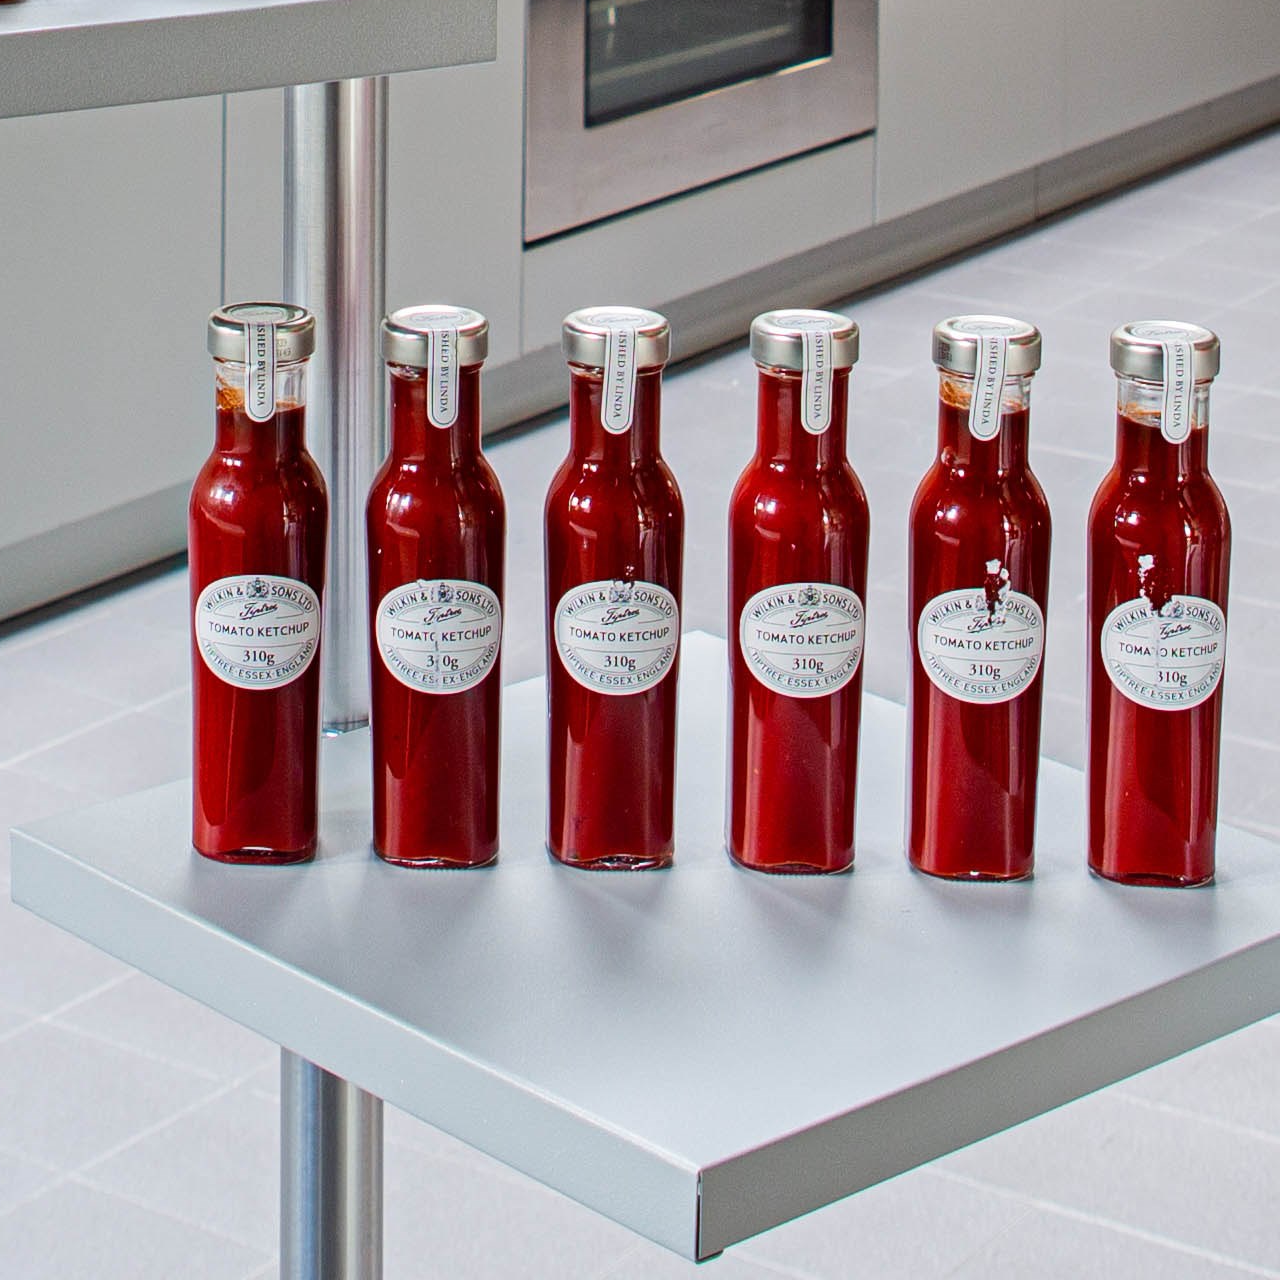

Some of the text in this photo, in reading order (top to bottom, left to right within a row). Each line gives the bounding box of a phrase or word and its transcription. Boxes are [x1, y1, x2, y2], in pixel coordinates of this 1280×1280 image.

[257, 373, 266, 406] LINDA
[440, 380, 449, 413] LINDA
[613, 385, 625, 419] LINDA
[813, 385, 823, 419] LINDA
[981, 392, 993, 425] LINDA
[1173, 395, 1184, 428] LINDA
[205, 586, 312, 611] WILKIN & SONS LTD
[388, 593, 417, 616] WILKIN
[455, 590, 481, 605] SONS
[481, 597, 495, 617] LTD
[566, 591, 672, 618] WILKIN & SONS LTD
[752, 594, 859, 619] WILKIN & SONS LTD
[929, 599, 961, 623] WILKIN
[965, 600, 973, 609] &
[1024, 606, 1038, 626] LTD
[1115, 607, 1222, 631] WILKIN SONS LTD
[209, 621, 311, 638] TOMATO KETCHUP
[441, 625, 492, 642] KETCHUP
[570, 626, 670, 642] TOMATO KETCHUP
[756, 629, 857, 645] TOMATO KETCHUP
[934, 634, 1035, 651] TOMATO KETCHUP
[1171, 642, 1219, 658] KETCHUP
[242, 649, 276, 667] 310g
[426, 654, 460, 671] 30g
[604, 655, 637, 672] 310g
[792, 657, 824, 674] 310g
[968, 663, 1001, 681] 310g
[1158, 670, 1188, 688] 310g
